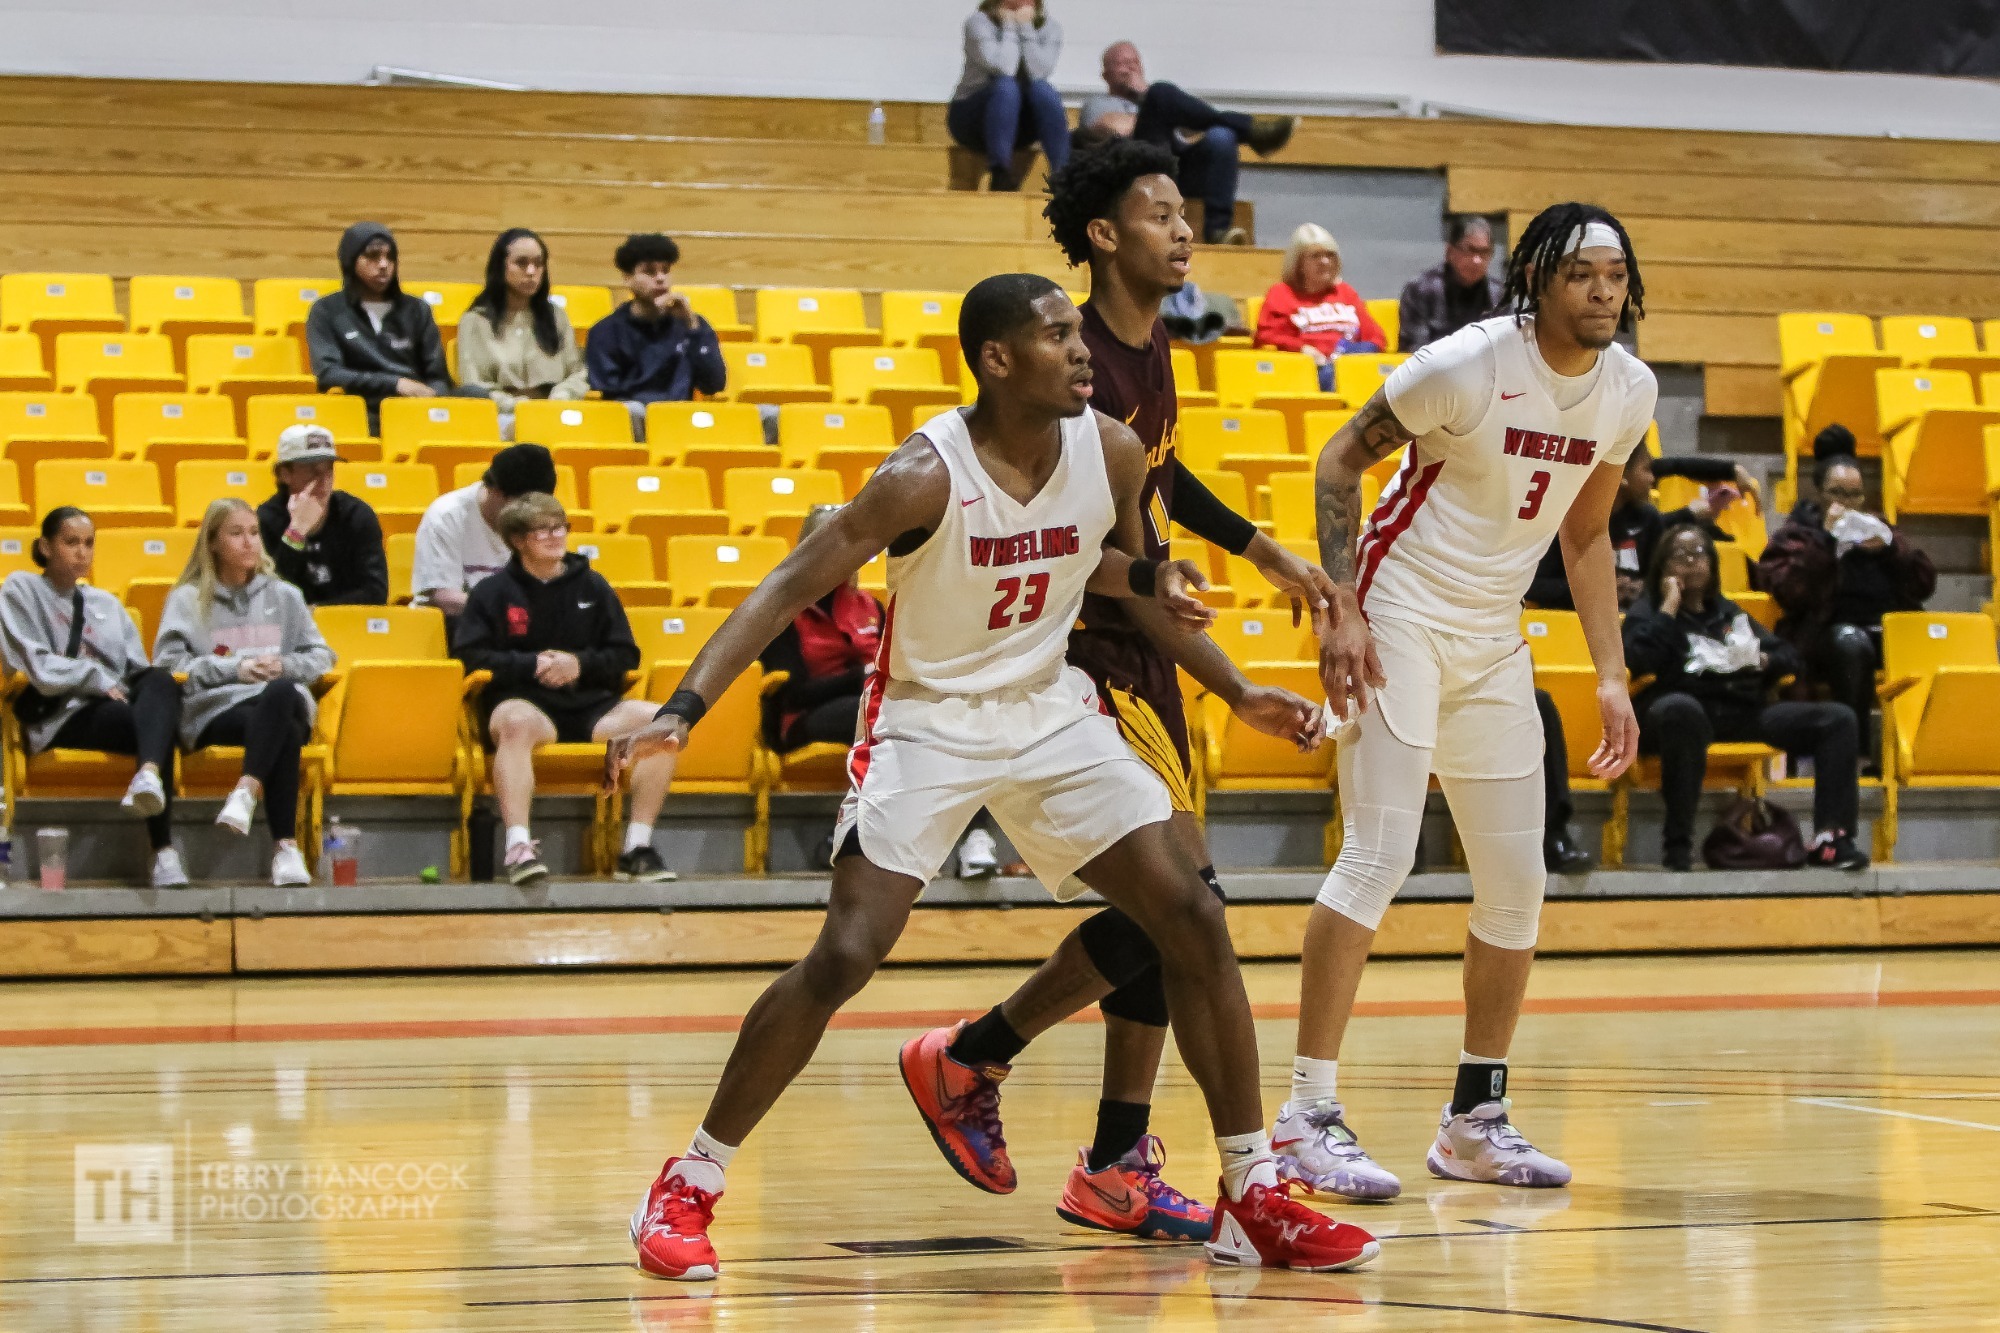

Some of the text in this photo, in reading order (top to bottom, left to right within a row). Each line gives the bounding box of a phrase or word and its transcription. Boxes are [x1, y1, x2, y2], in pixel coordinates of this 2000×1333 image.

[1503, 427, 1597, 466] WHEELING
[1517, 470, 1551, 521] 3
[969, 525, 1080, 567] WHEELING
[987, 572, 1050, 631] 23
